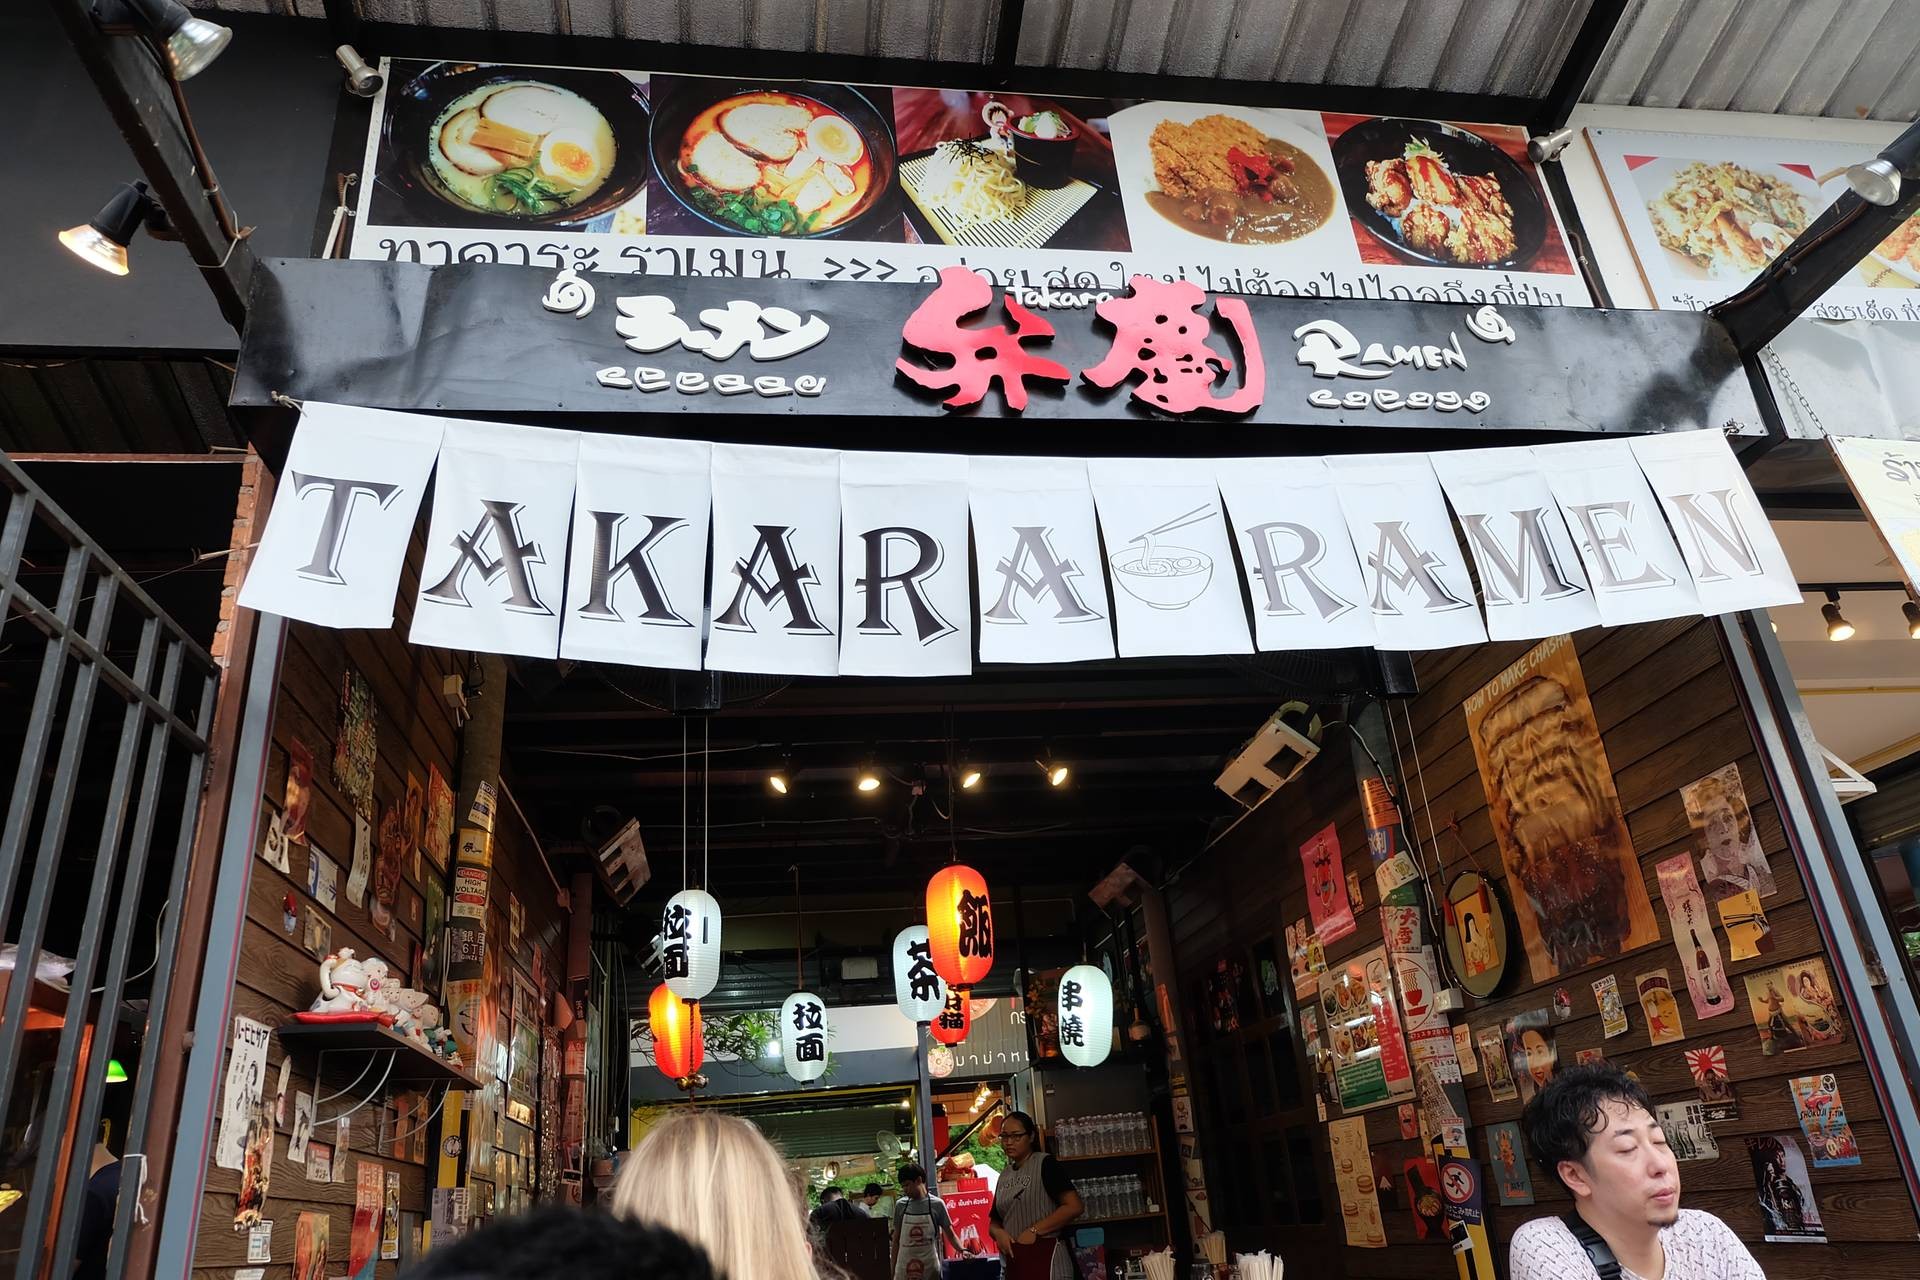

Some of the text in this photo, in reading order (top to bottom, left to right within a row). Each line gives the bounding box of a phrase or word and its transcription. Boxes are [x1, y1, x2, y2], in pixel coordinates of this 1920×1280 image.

[290, 470, 1764, 647] TAKARA RAMEN
[1485, 680, 1499, 701] TO
[1501, 659, 1528, 691] MAKE
[464, 878, 482, 887] HIGH
[793, 1001, 824, 1062] 拉面
